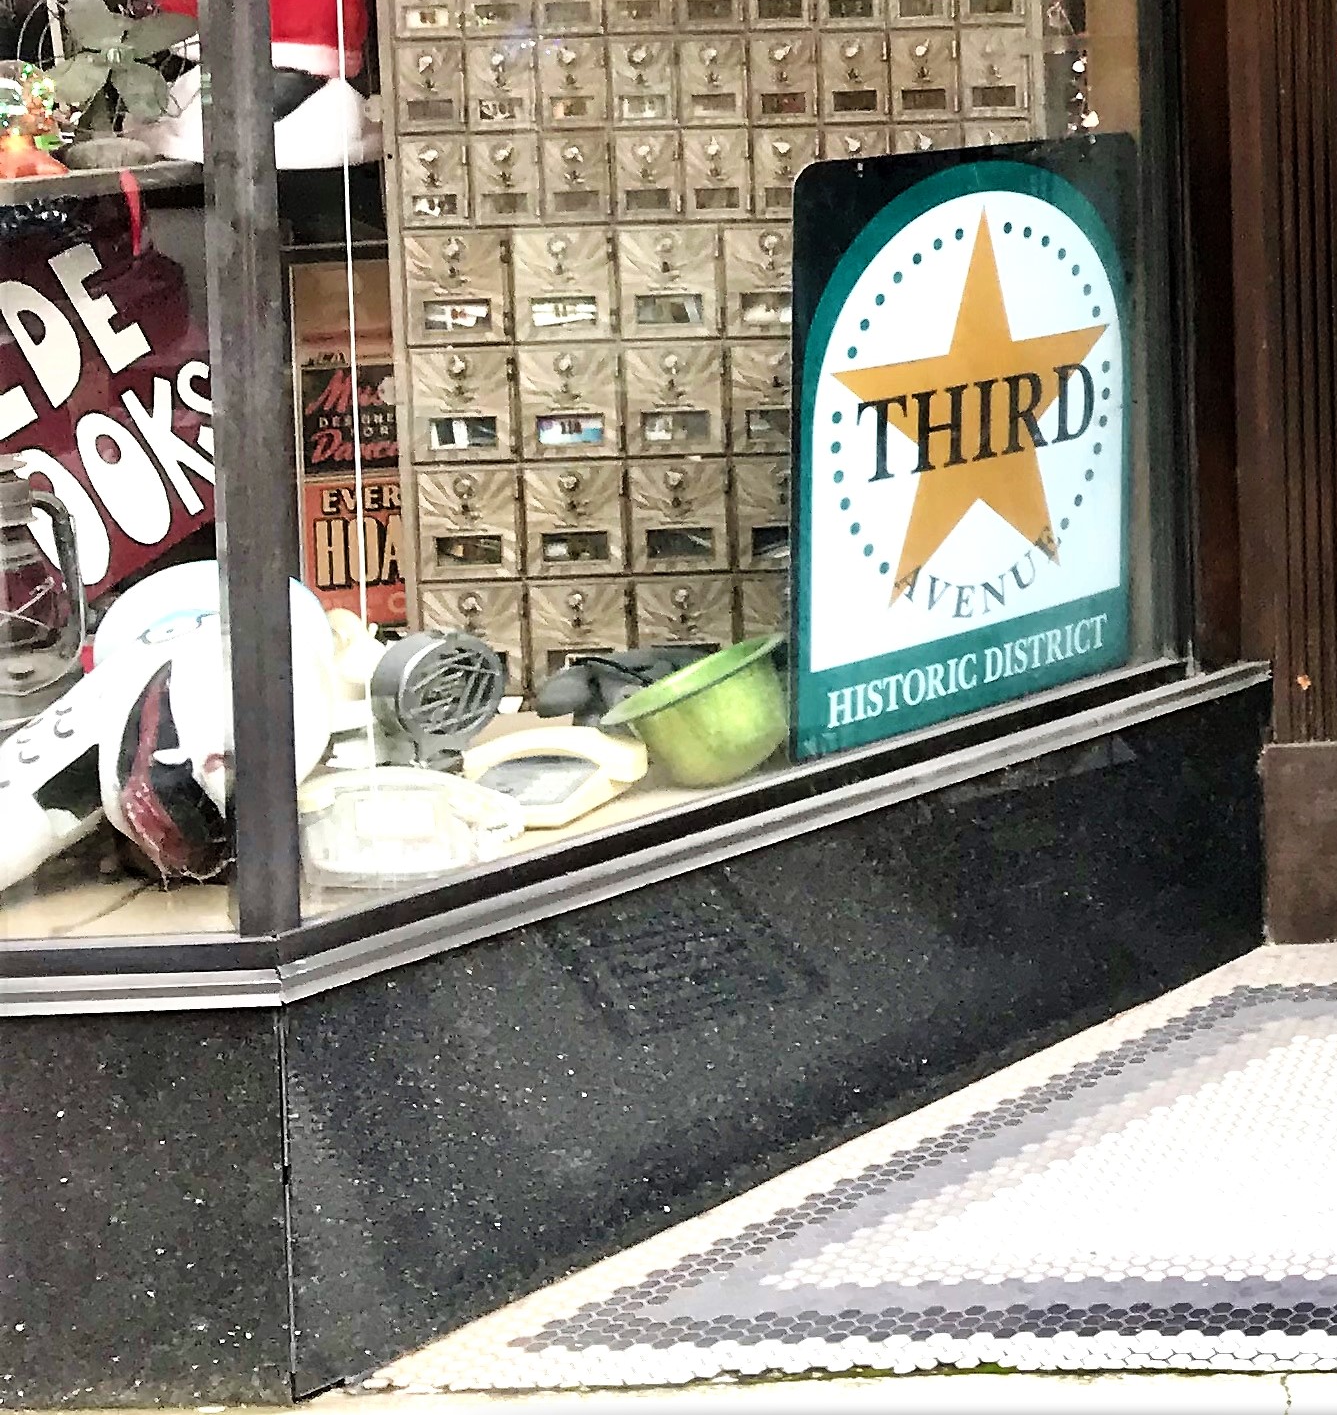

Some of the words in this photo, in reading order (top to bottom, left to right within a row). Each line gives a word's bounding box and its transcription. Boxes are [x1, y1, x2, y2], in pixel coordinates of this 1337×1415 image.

[856, 362, 1095, 484] THIRD
[894, 524, 1063, 620] AVENUE
[826, 651, 978, 730] HISTORIC
[983, 613, 1109, 686] DISTRICT
